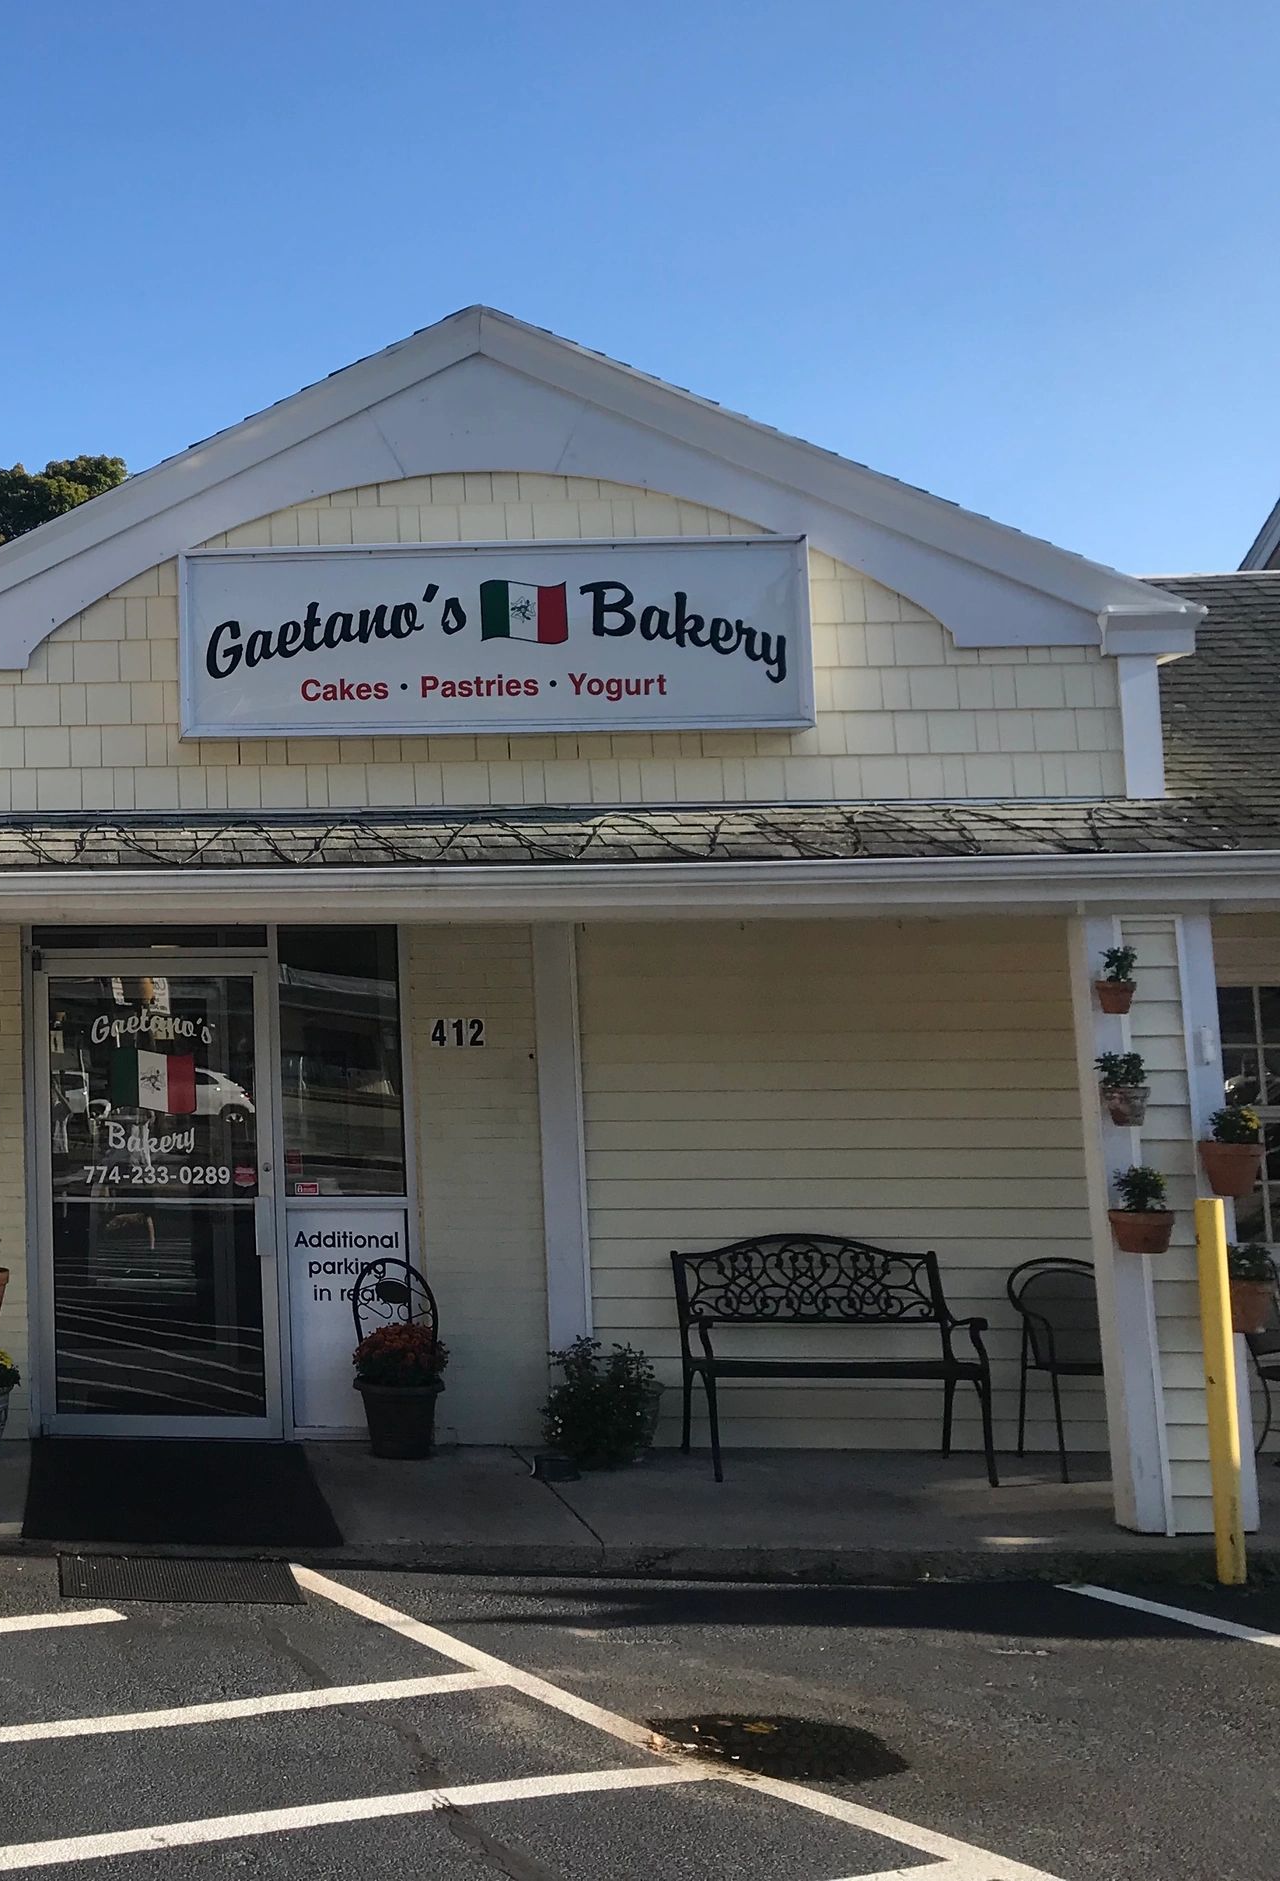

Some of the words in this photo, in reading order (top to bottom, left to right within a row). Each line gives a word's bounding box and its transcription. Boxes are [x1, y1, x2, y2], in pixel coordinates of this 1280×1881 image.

[205, 583, 469, 678] Gaetano's
[578, 579, 789, 685] Bakery
[300, 678, 390, 702] Cakes
[419, 674, 540, 701] Pastries
[568, 673, 668, 702] Yogurt
[90, 1008, 211, 1045] Gaetano's
[431, 1018, 486, 1048] 412
[104, 1121, 196, 1154] Bakery
[83, 1165, 231, 1186] 774-233-0289
[294, 1230, 399, 1249] Additional
[308, 1258, 387, 1279] parking
[313, 1284, 332, 1302] in
[340, 1287, 383, 1303] rea
